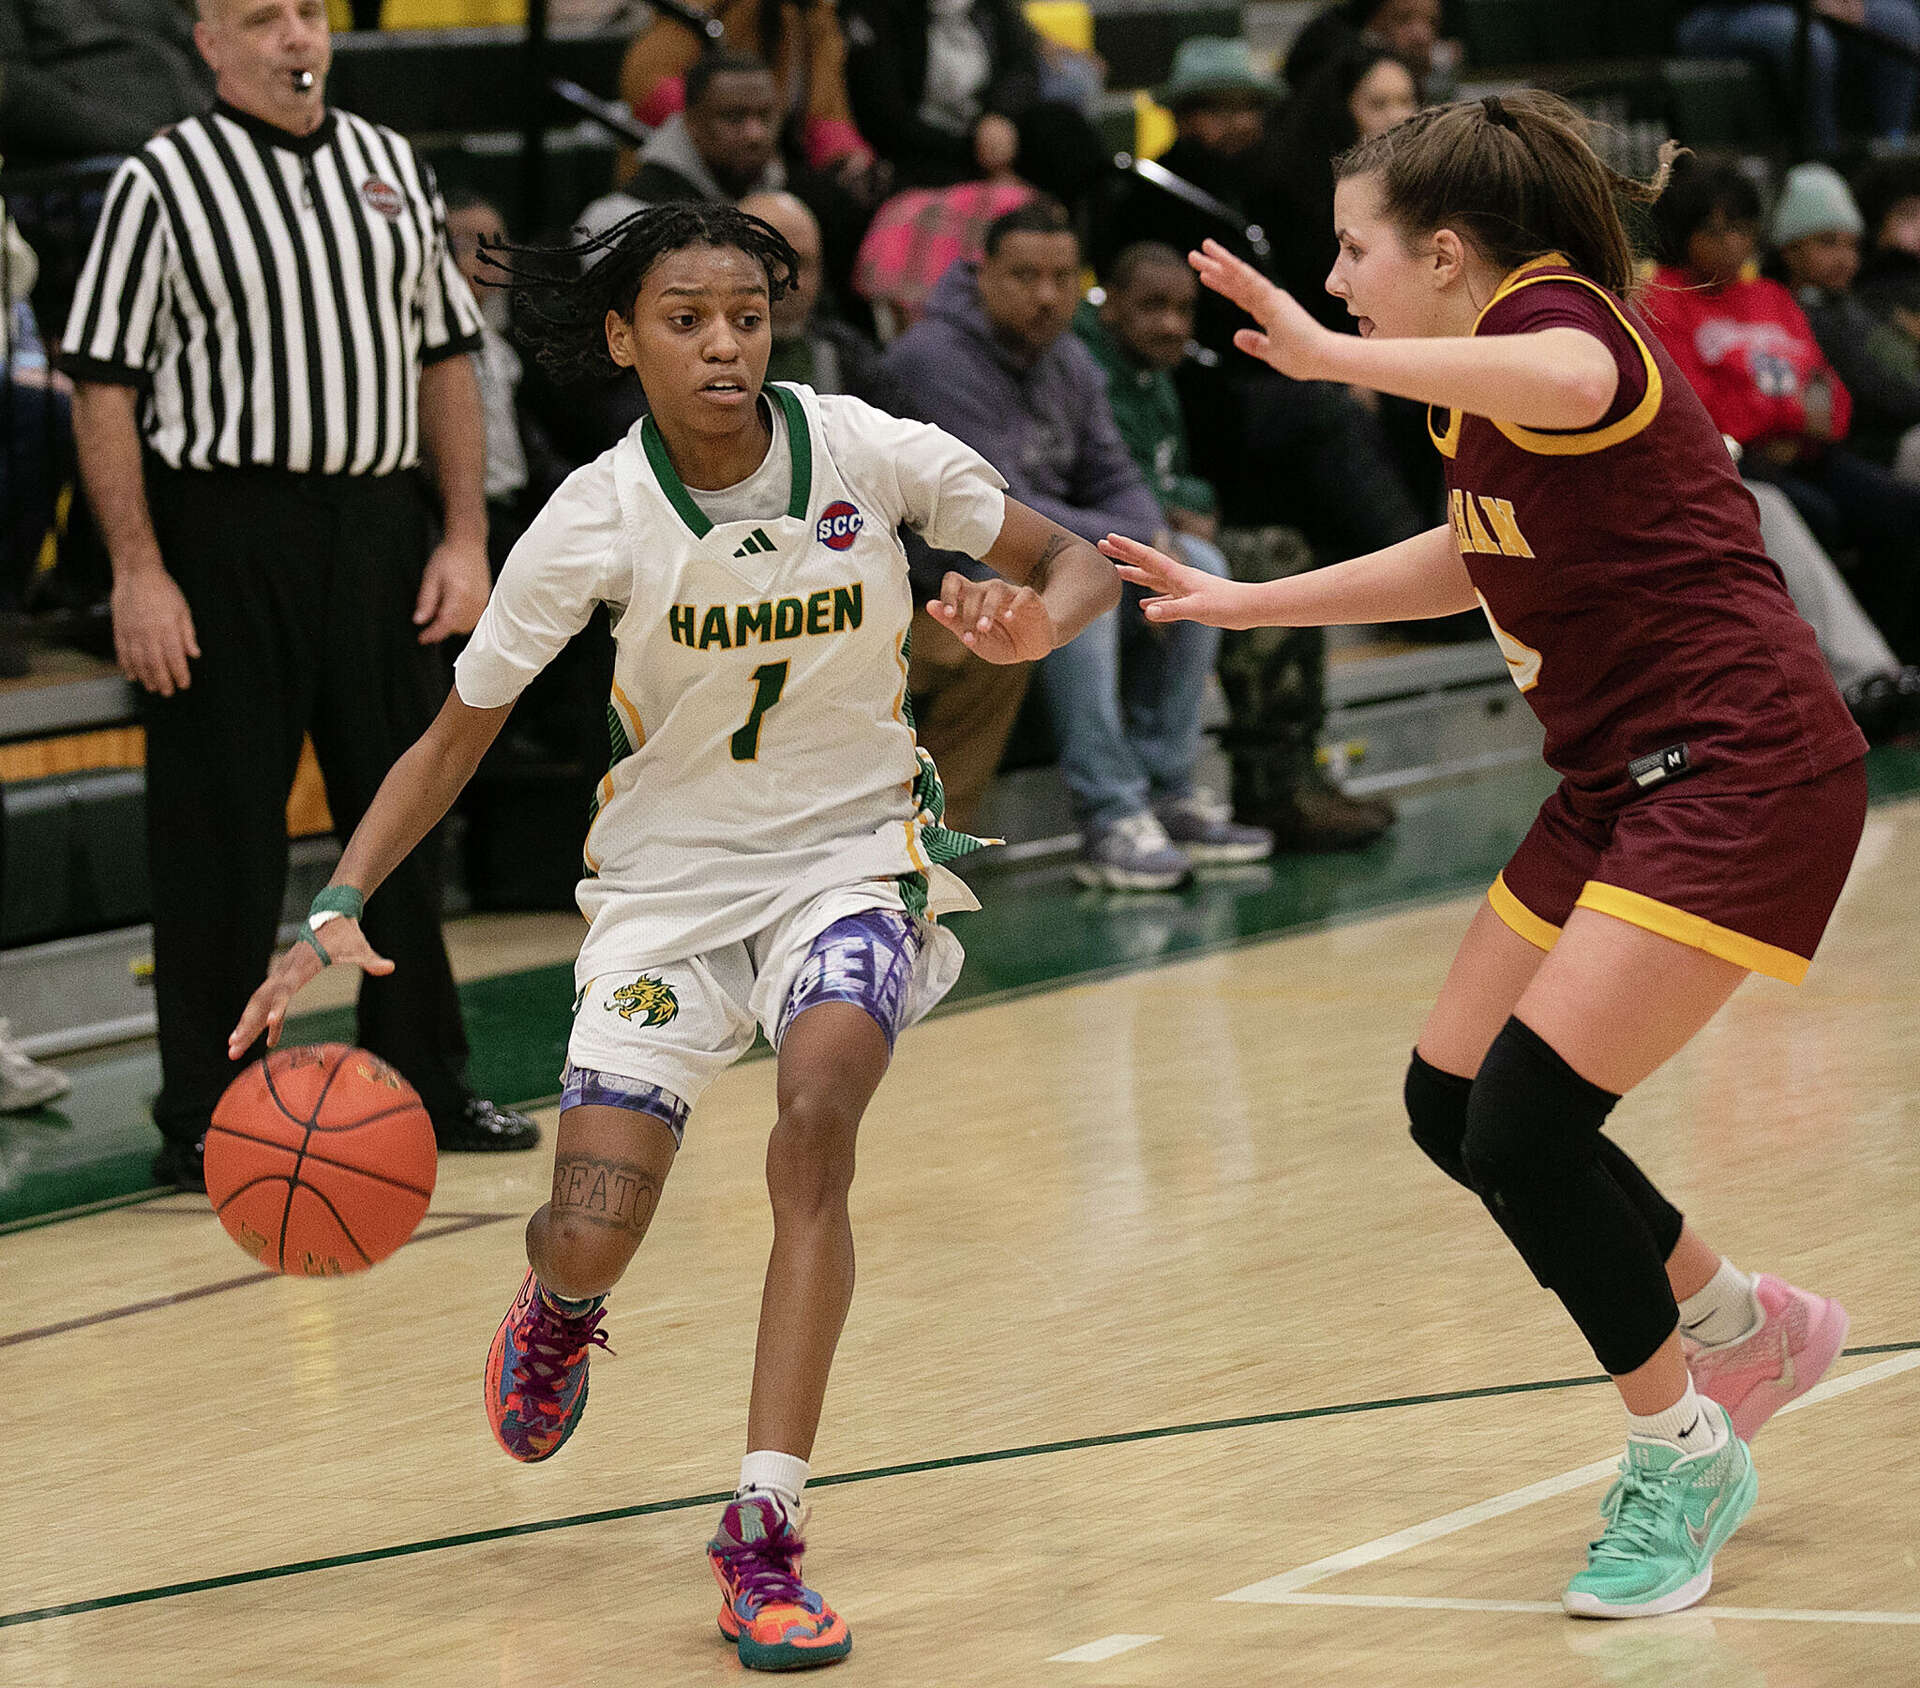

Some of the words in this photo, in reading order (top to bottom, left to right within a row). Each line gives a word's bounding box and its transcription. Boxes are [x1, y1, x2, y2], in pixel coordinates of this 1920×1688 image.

[817, 513, 863, 541] SCC
[1448, 488, 1536, 558] HAN
[668, 581, 863, 651] HAMDEN
[729, 658, 791, 763] 1
[1667, 751, 1681, 767] M
